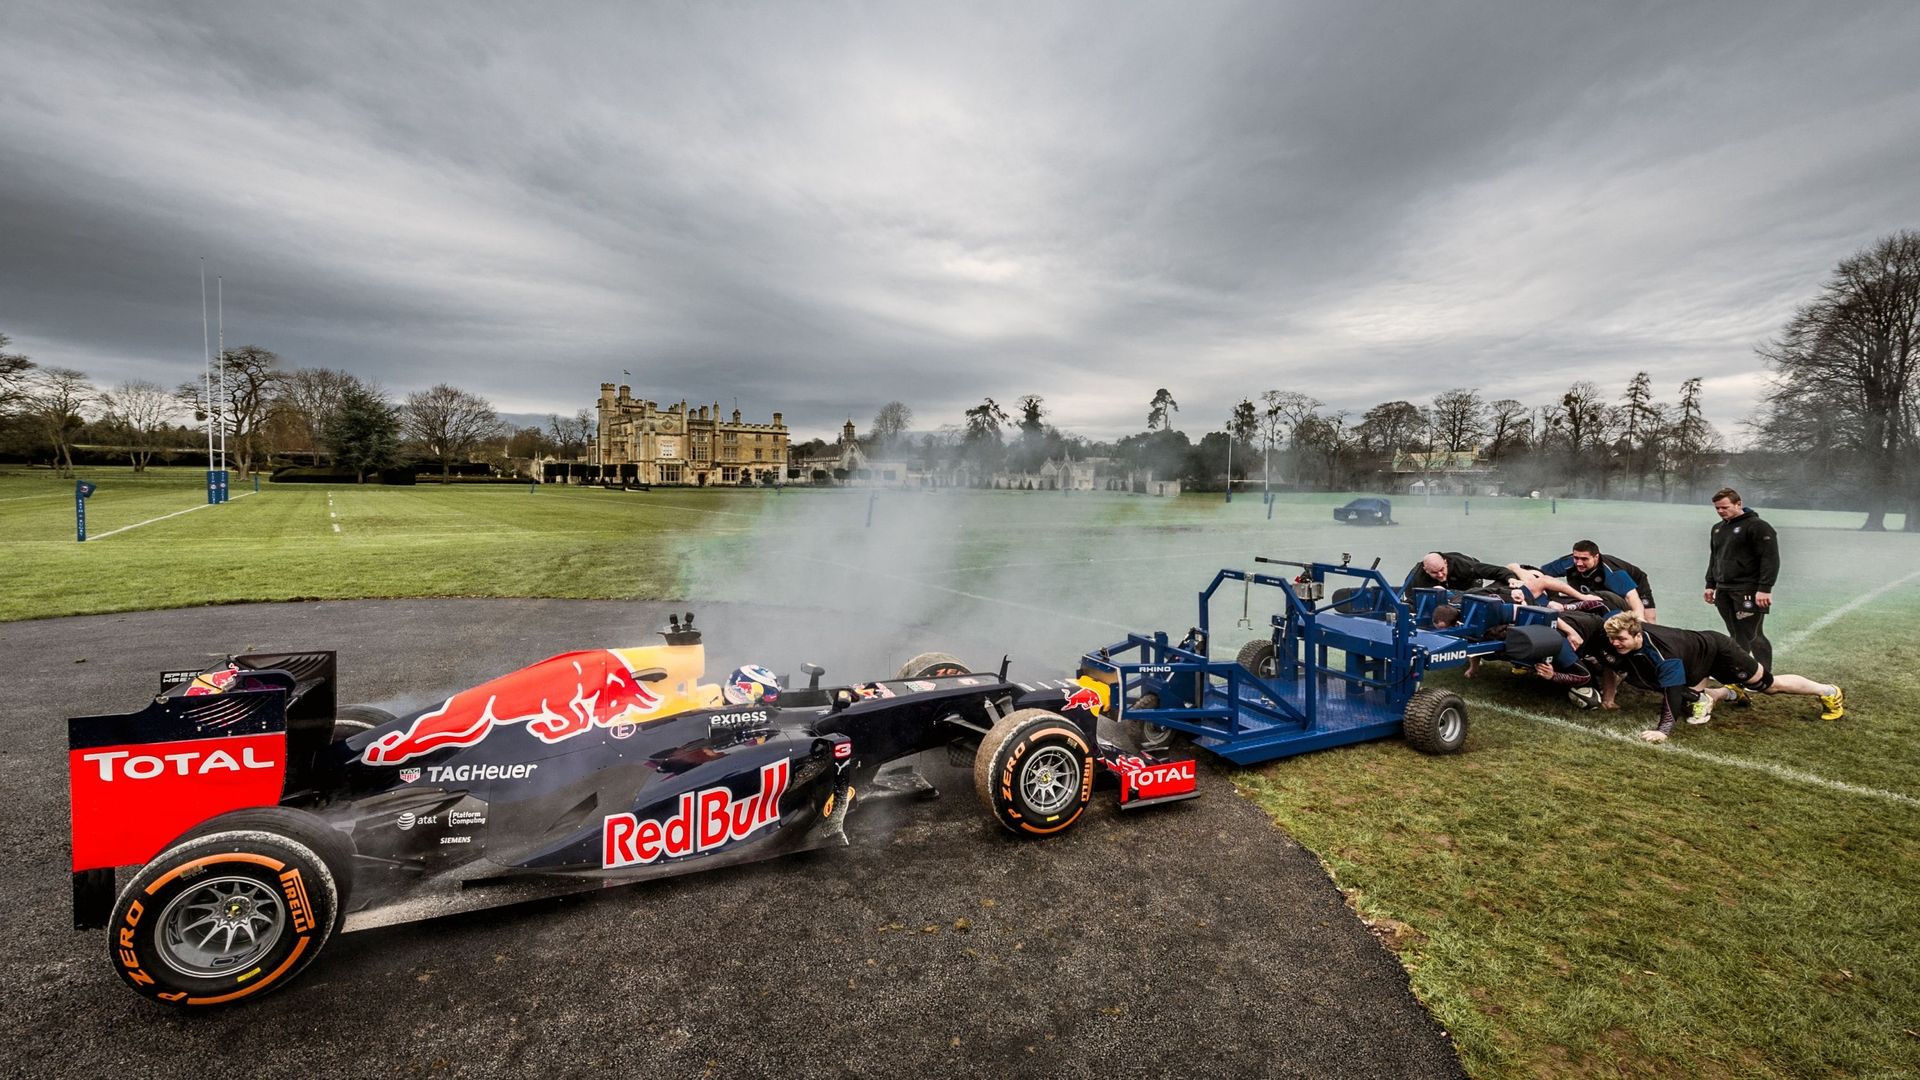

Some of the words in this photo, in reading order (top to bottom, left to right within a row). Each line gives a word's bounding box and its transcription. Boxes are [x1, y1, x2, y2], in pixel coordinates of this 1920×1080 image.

[1431, 650, 1467, 663] RHINO
[711, 709, 767, 726] exness
[835, 743, 851, 757] 3
[83, 748, 275, 781] TOTAL
[1002, 741, 1026, 801] ZERO
[1081, 757, 1093, 802] PIRELLI
[1127, 766, 1194, 790] TOTAL
[417, 815, 438, 825] at&t
[452, 811, 481, 819] Platform
[452, 817, 486, 825] Computing
[440, 836, 472, 844] SIEMENS
[279, 868, 315, 933] PIRELLI
[119, 899, 155, 986] ZERO
